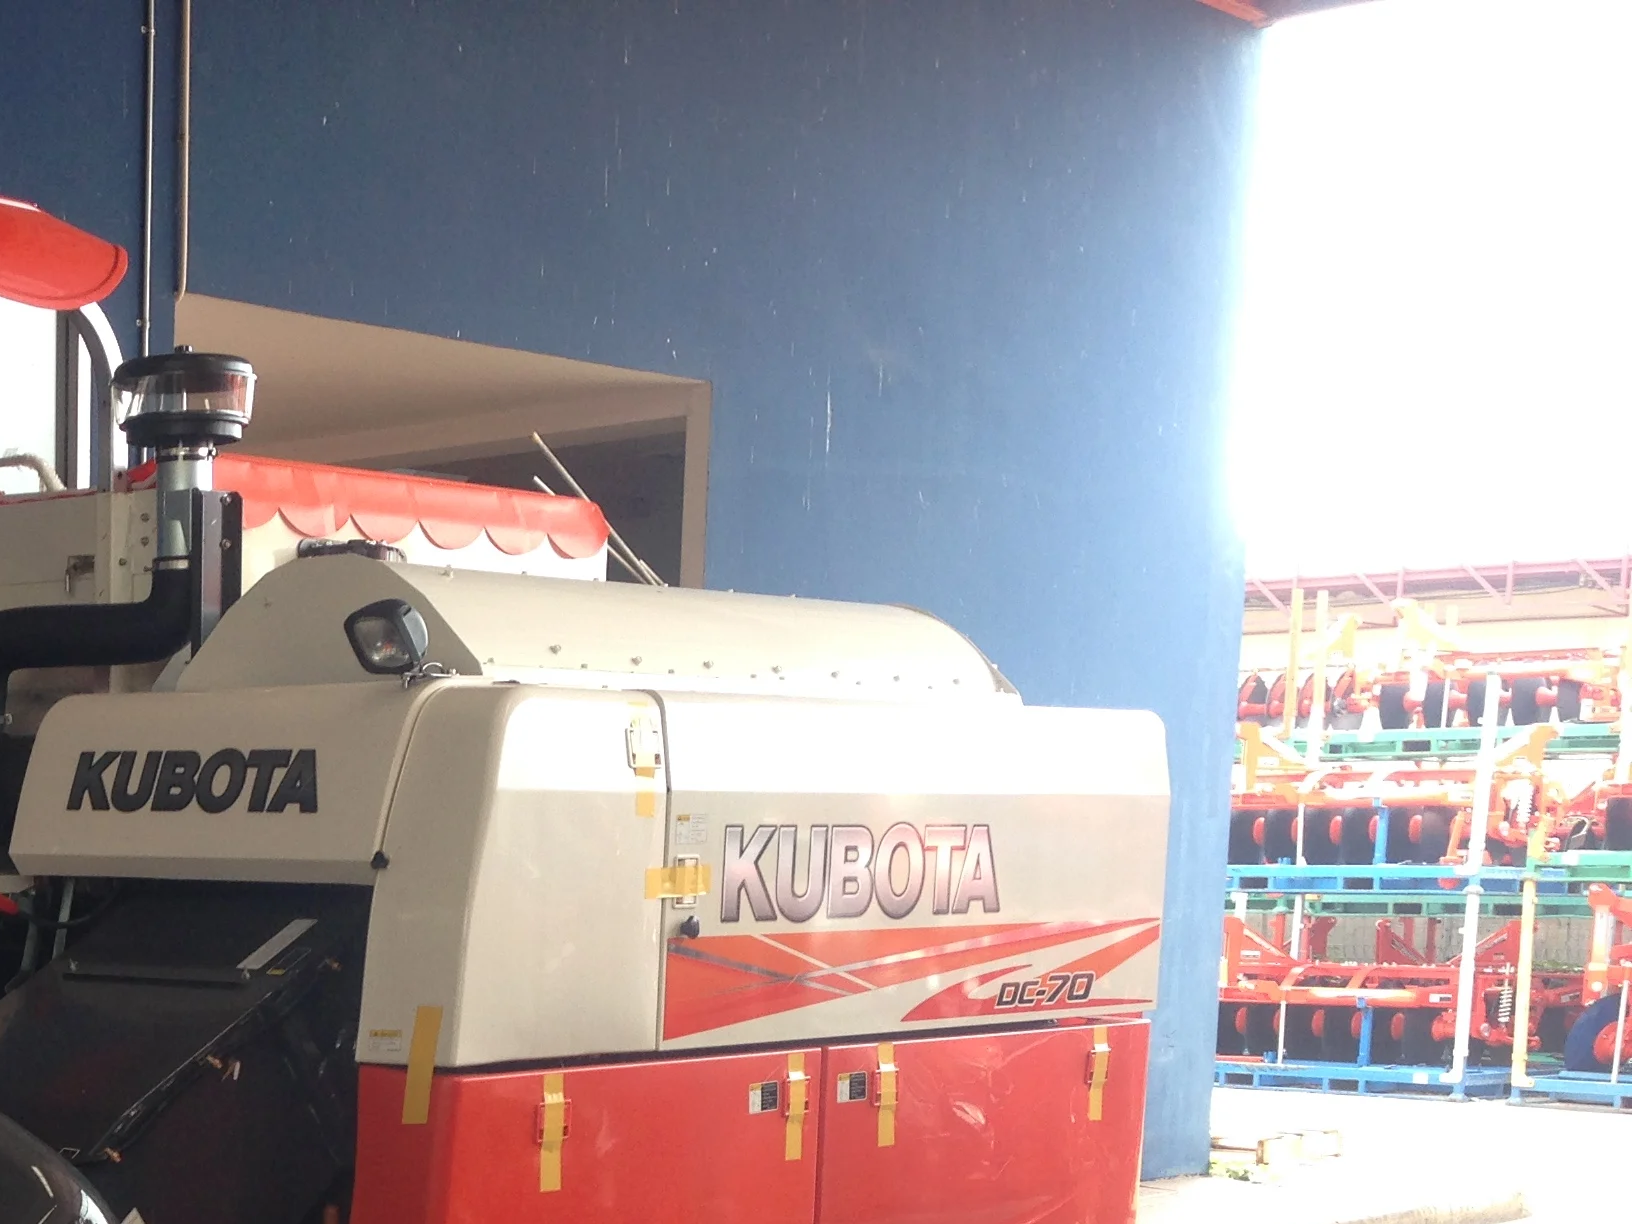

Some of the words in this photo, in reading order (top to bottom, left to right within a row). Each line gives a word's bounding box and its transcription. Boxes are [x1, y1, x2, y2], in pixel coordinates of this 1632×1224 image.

[67, 748, 318, 813] KUBOTA
[720, 822, 1000, 923] KUBOTA
[995, 972, 1096, 1007] DC-70
